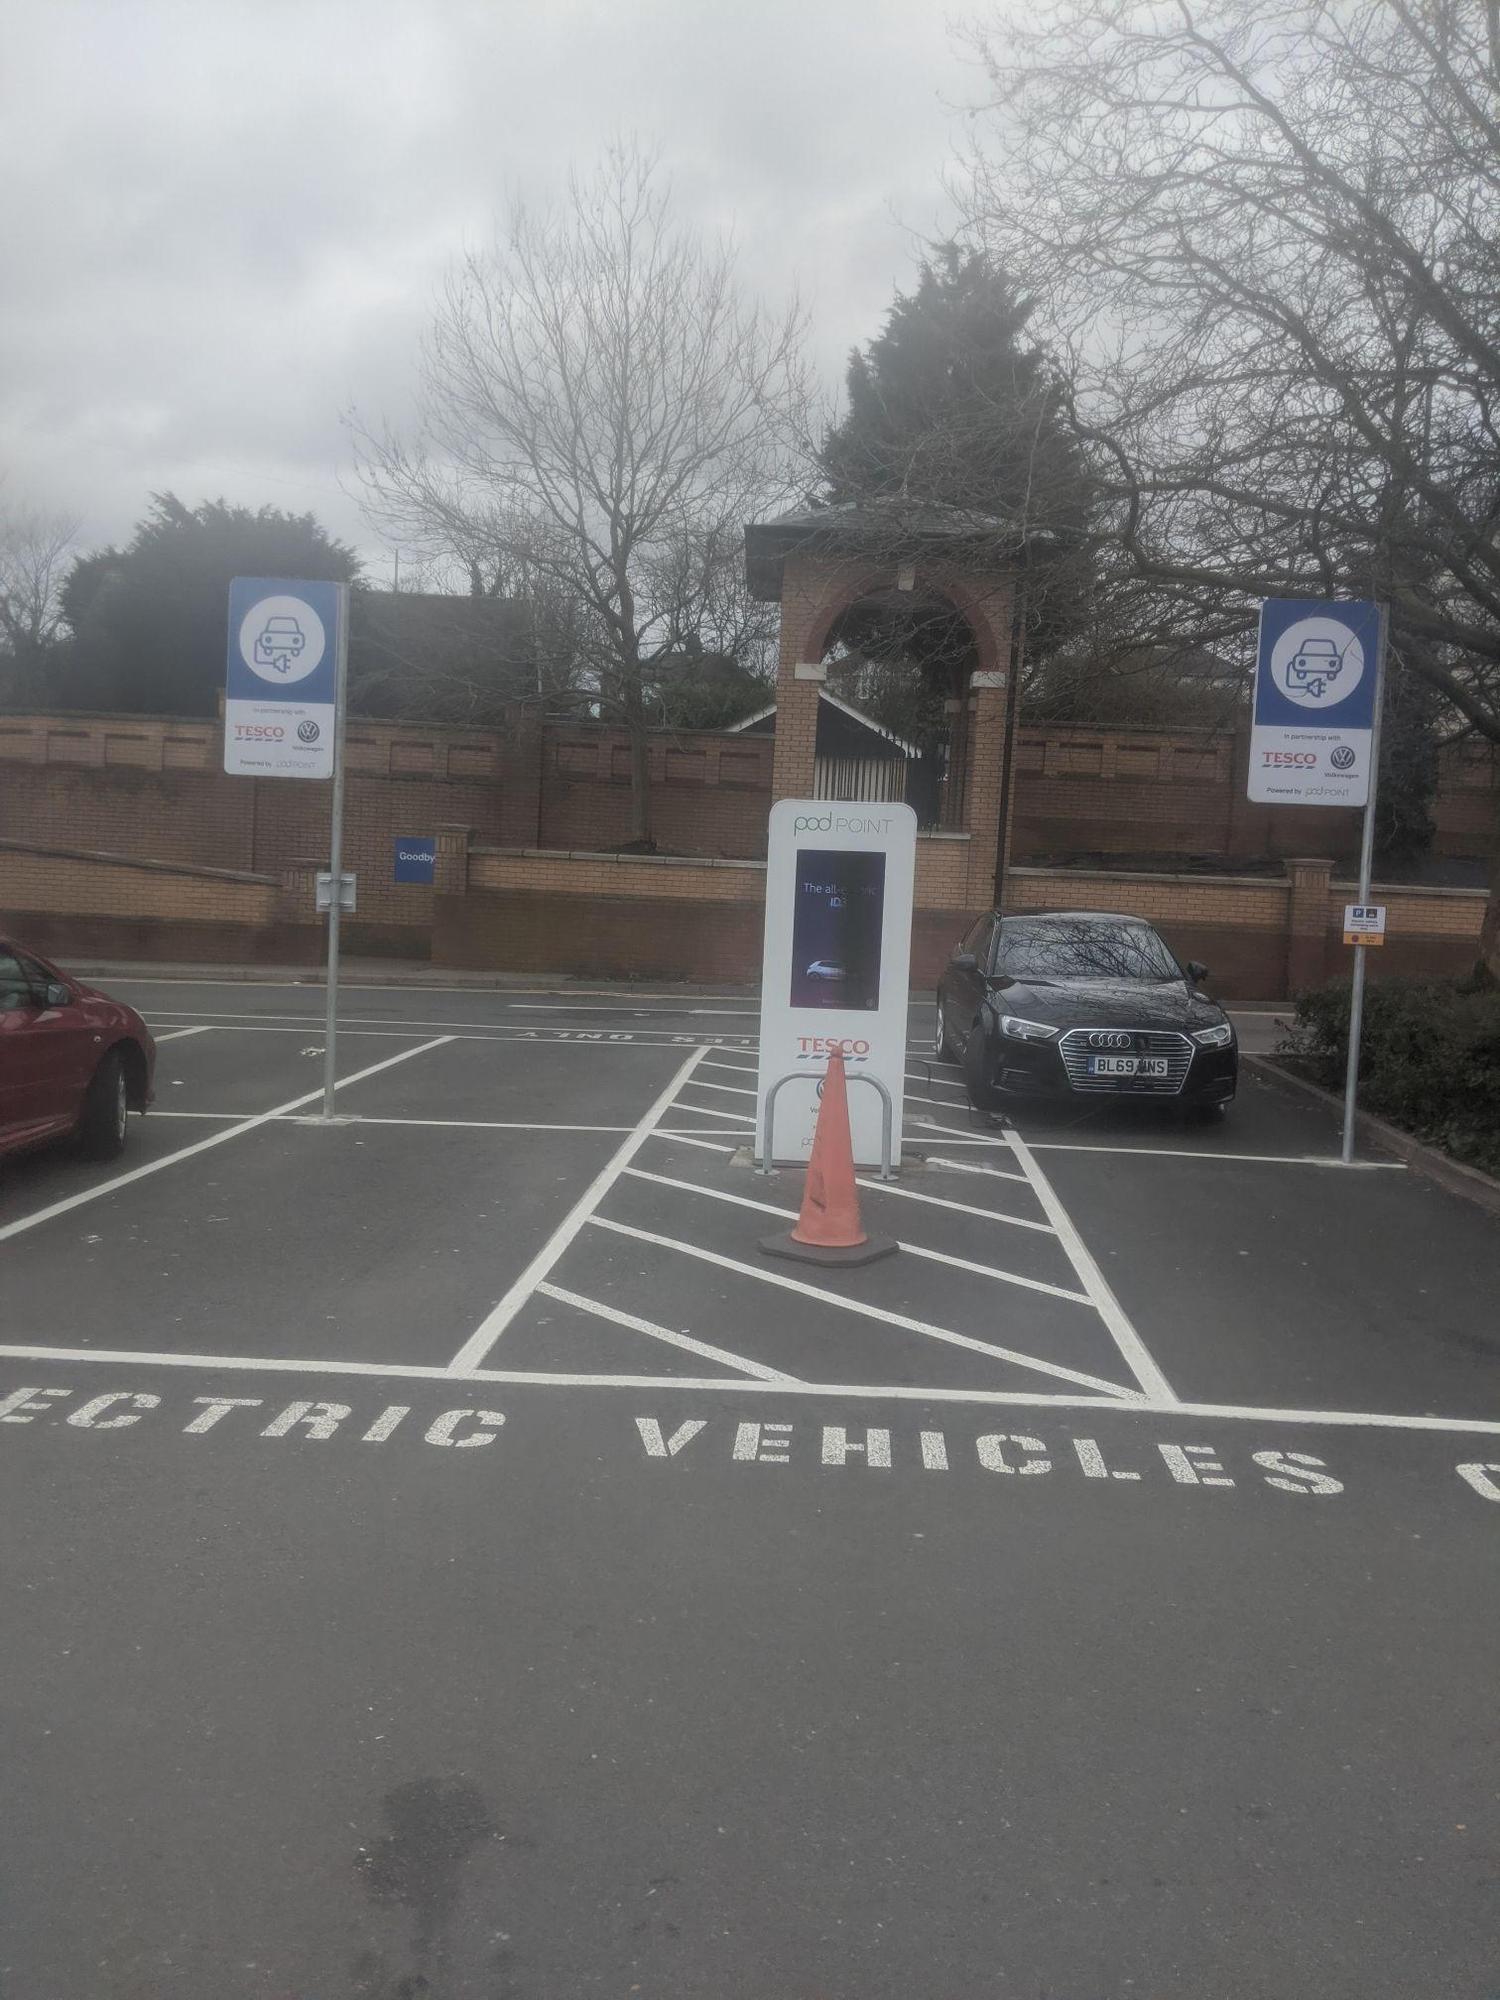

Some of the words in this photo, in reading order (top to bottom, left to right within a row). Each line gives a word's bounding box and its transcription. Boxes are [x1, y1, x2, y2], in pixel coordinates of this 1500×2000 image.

[235, 725, 284, 738] TESCO
[1263, 752, 1317, 764] TESCO
[1266, 786, 1292, 794] Powered
[1293, 787, 1301, 795] by
[1324, 789, 1349, 797] POINT
[794, 811, 832, 837] pod
[836, 818, 894, 833] POINT
[804, 883, 822, 894] The
[797, 1037, 870, 1054] TESCO
[1097, 1059, 1134, 1073] BL69
[635, 1418, 1345, 1495] VEHICLES
